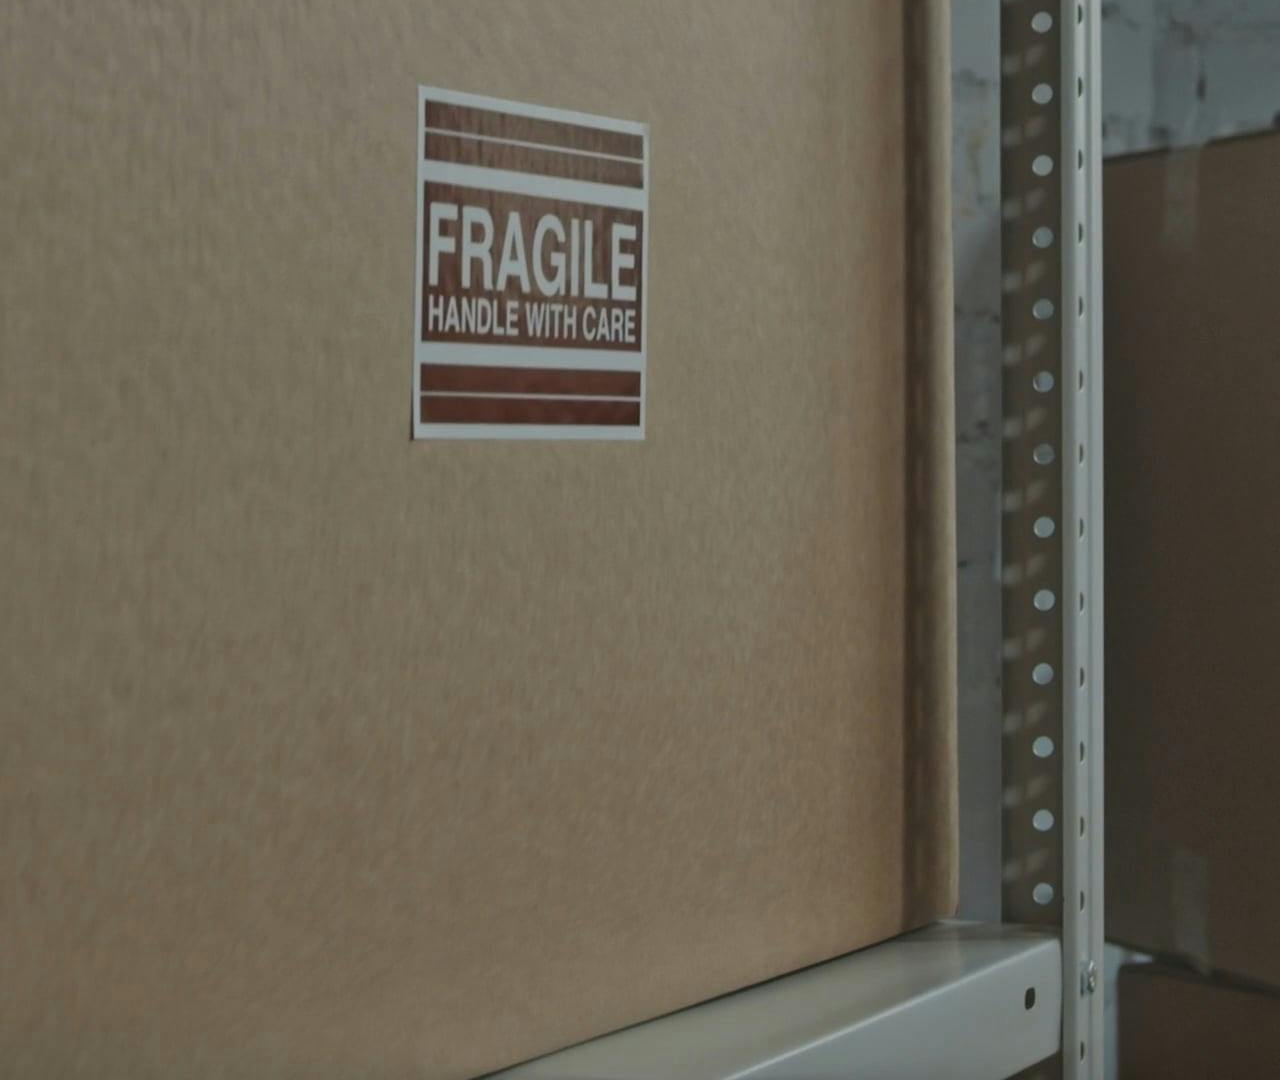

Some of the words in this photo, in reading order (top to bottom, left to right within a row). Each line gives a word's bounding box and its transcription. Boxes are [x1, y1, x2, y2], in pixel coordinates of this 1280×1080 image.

[428, 201, 637, 302] FRAGILE
[428, 294, 519, 337] HANDLE
[525, 302, 577, 340] WITH
[582, 306, 637, 343] CARE
